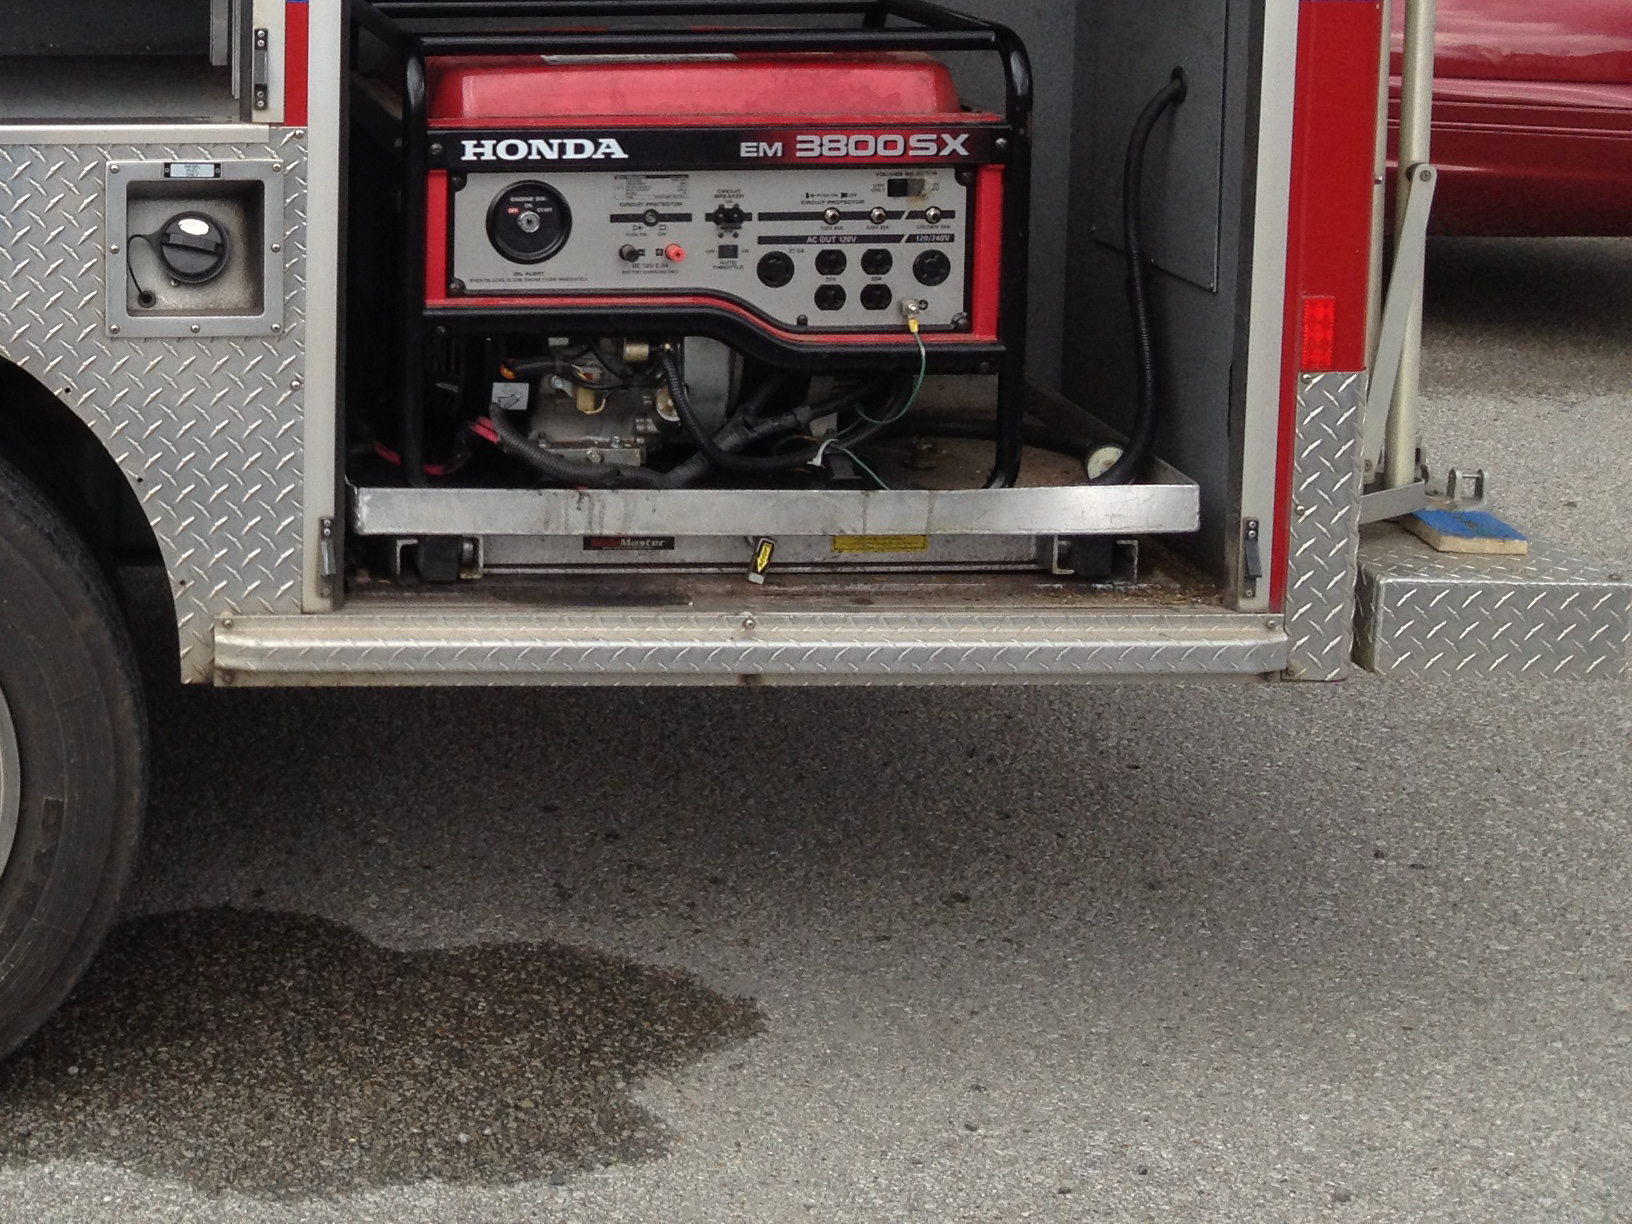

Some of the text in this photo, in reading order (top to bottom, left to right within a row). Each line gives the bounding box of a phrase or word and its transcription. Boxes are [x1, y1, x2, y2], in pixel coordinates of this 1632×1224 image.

[461, 138, 629, 160] HONDA
[740, 142, 783, 158] EM
[806, 236, 857, 244] AC OUT 120V
[916, 234, 950, 242] 120/240V
